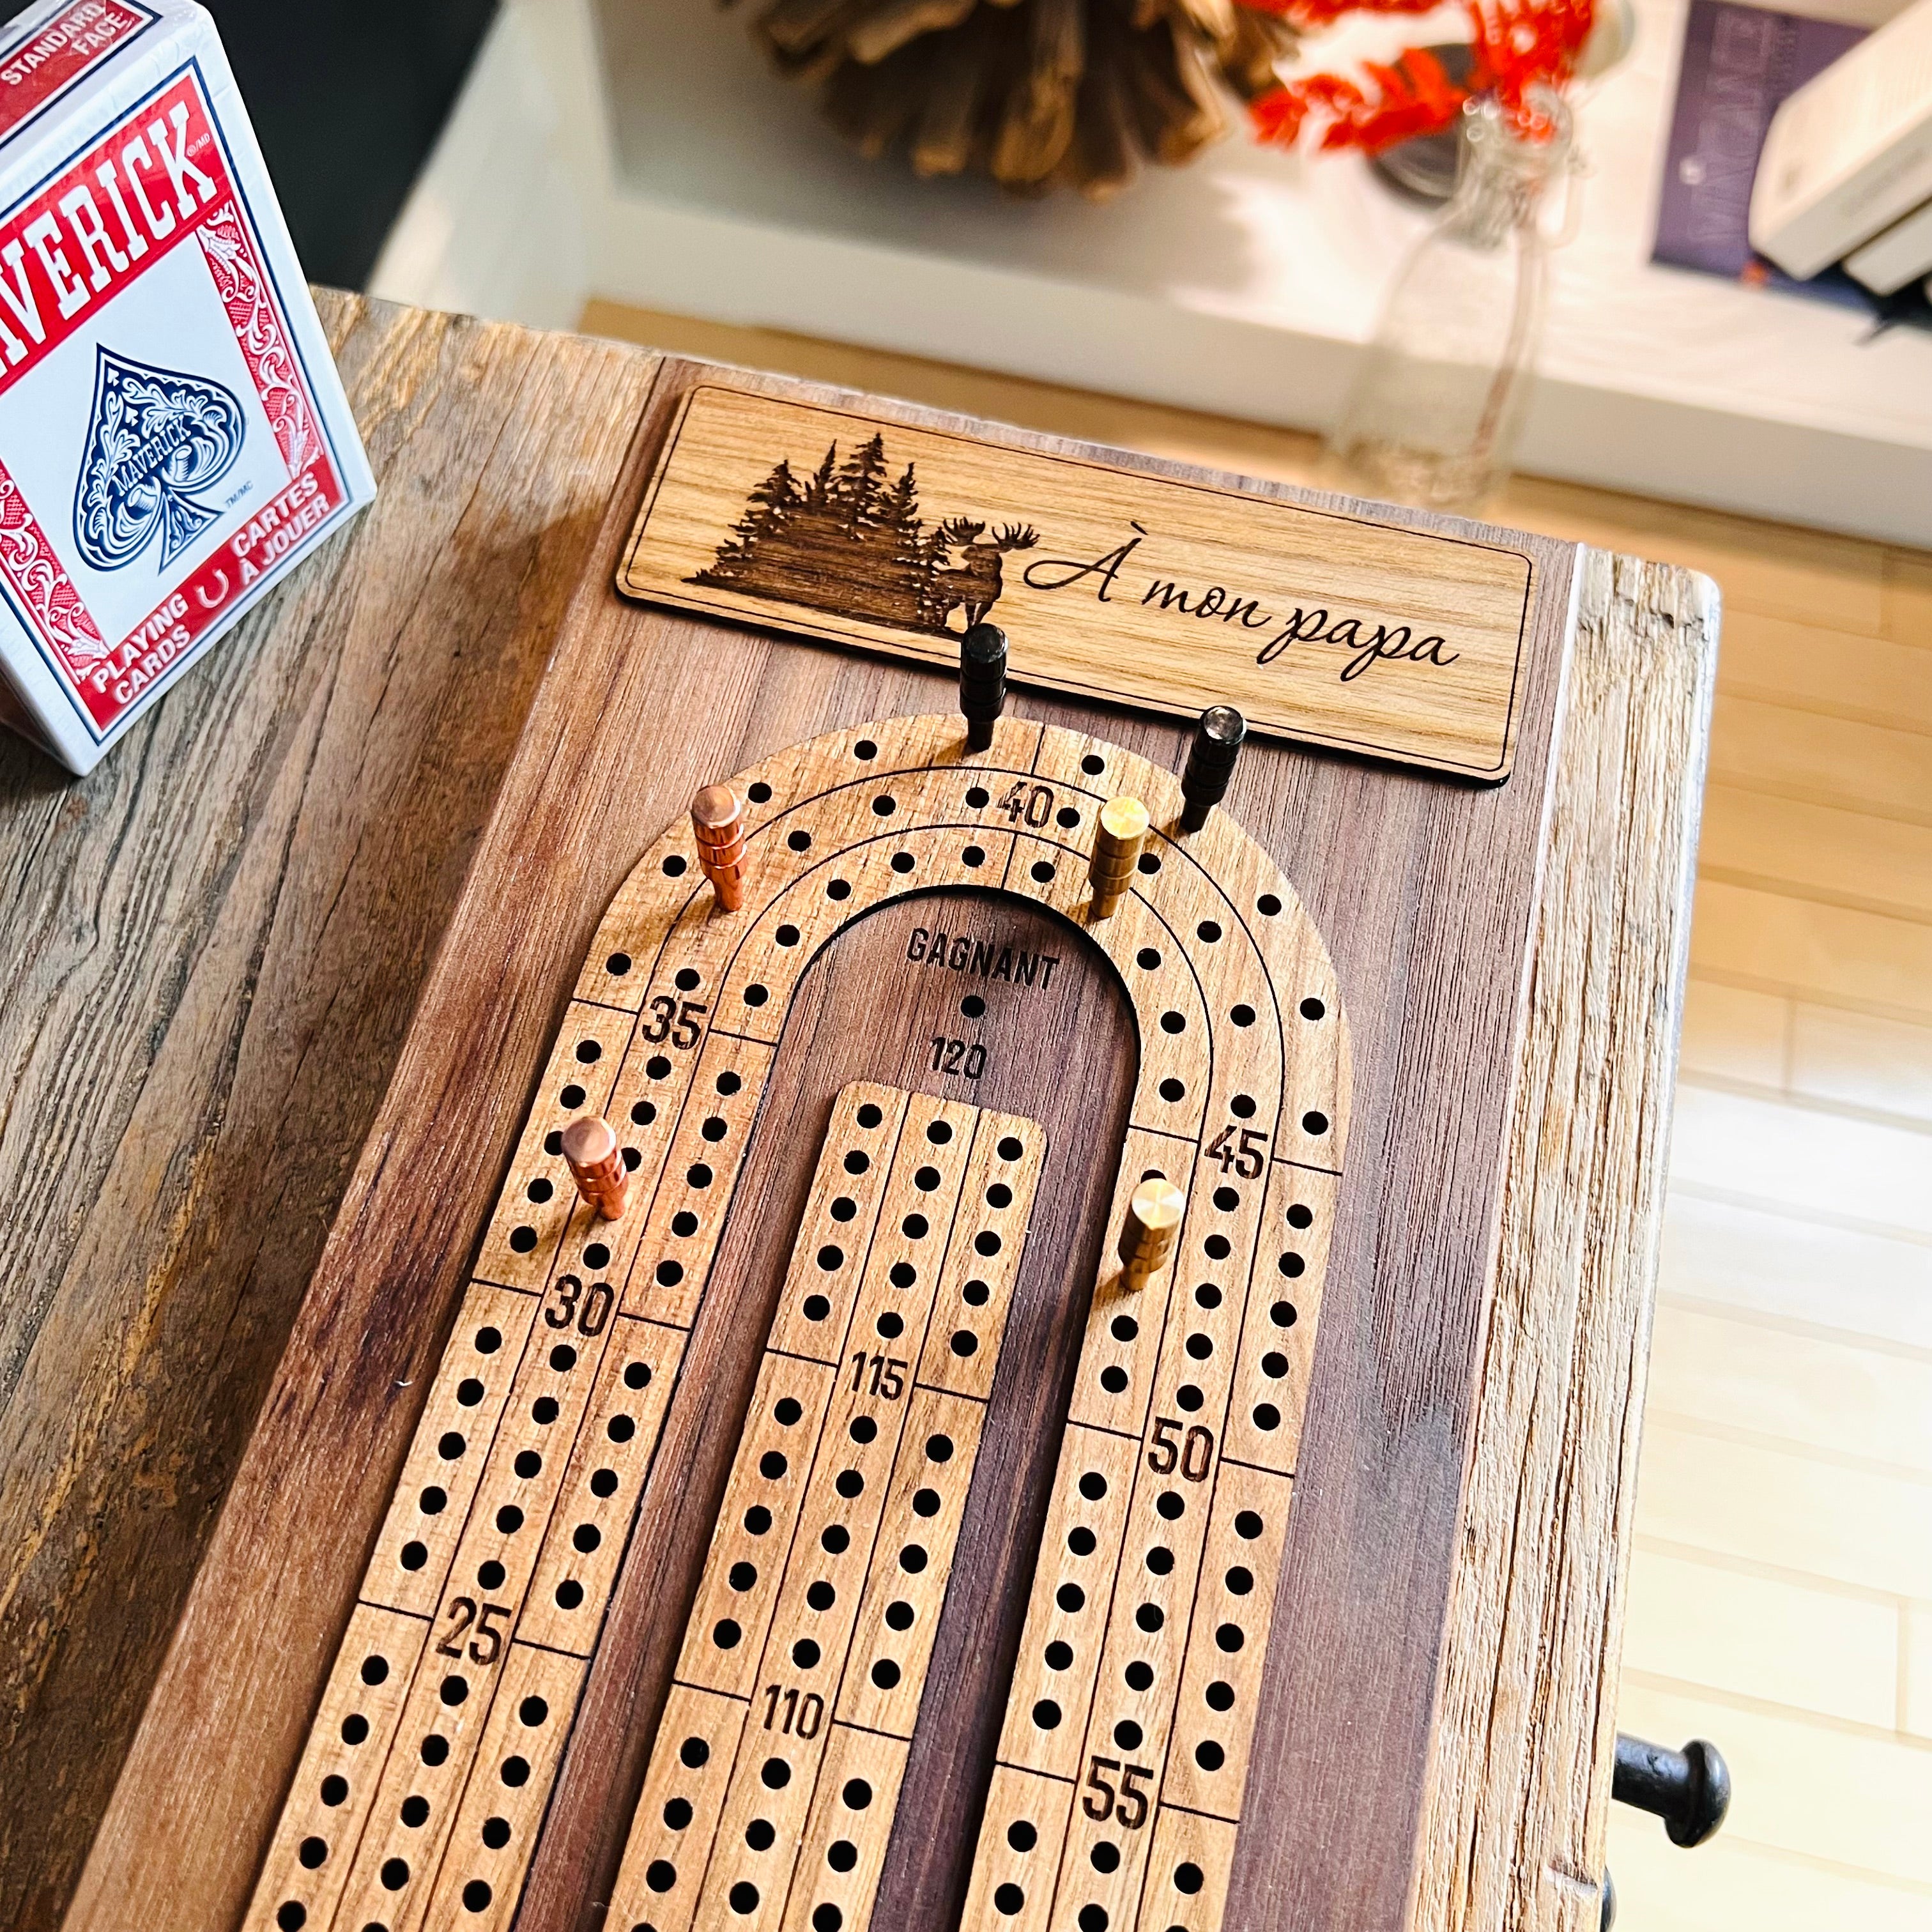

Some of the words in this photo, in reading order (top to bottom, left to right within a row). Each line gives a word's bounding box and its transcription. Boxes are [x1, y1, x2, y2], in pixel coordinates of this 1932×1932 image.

[1, 1, 106, 85] STANDARD
[70, 12, 128, 56] FACE
[111, 415, 192, 496] MAVERICK
[231, 471, 318, 558] CARTES
[262, 493, 330, 566] JOUER
[1022, 521, 1148, 602] À
[1141, 579, 1273, 628] mon
[1256, 607, 1460, 682] papa
[92, 592, 189, 694] PLAYING
[113, 624, 191, 705] CARDS
[997, 781, 1054, 828] 40
[907, 928, 1060, 990] GAGNANT
[642, 995, 708, 1050] 35
[930, 1036, 987, 1080] 120
[1204, 1124, 1269, 1179] 45
[544, 1273, 615, 1337] 30
[852, 1351, 908, 1400] 115
[1148, 1416, 1214, 1482] 50
[436, 1597, 512, 1666] 25
[763, 1683, 824, 1740] 110
[1082, 1755, 1154, 1830] 55
